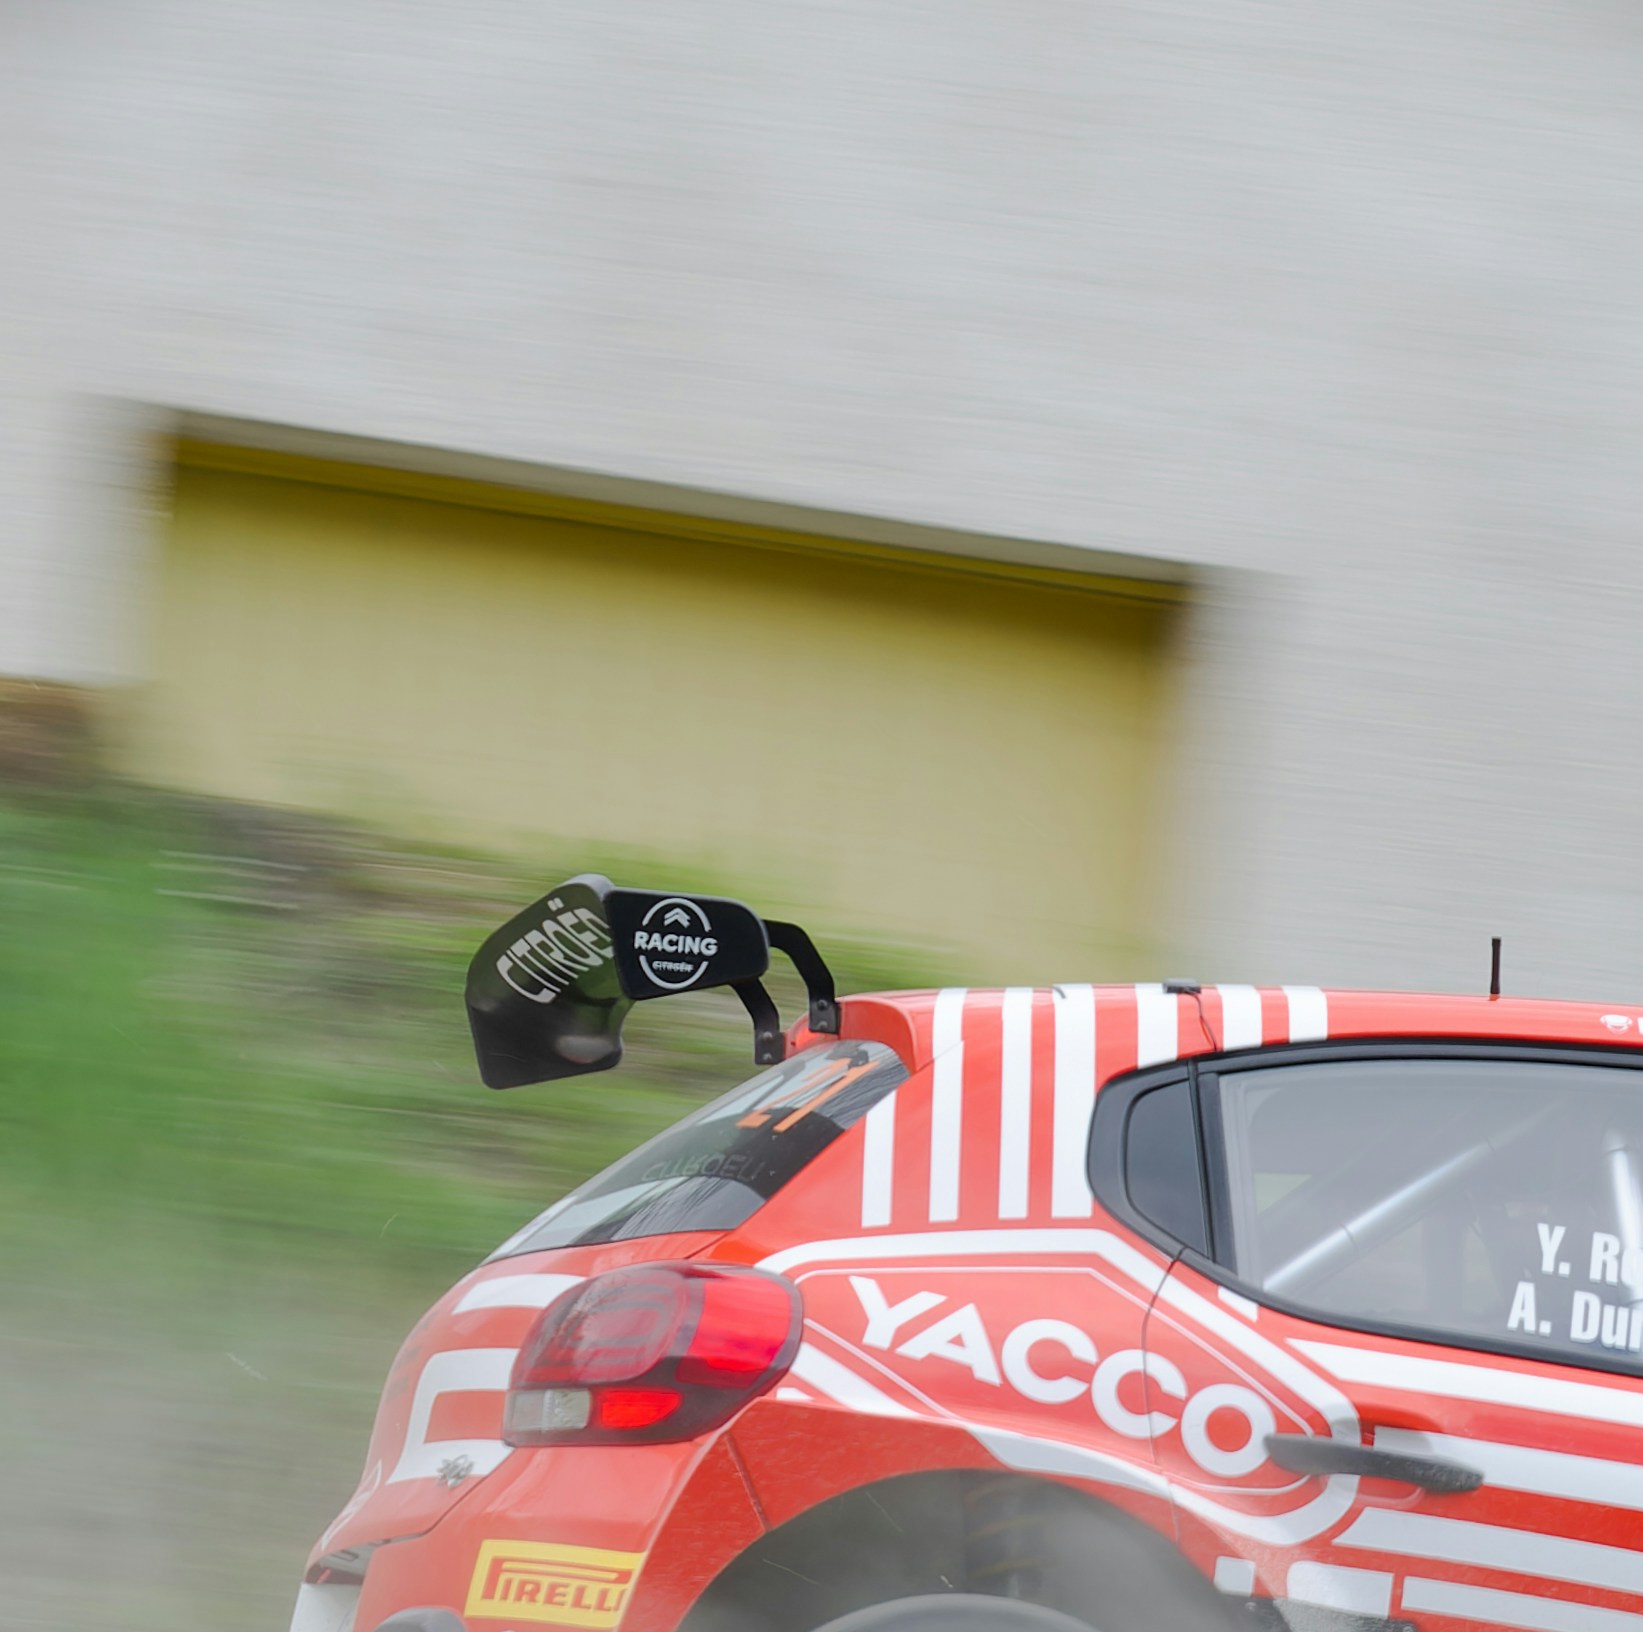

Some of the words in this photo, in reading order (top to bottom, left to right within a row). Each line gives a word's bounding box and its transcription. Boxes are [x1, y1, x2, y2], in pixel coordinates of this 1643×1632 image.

[634, 930, 717, 956] RACING
[1536, 1222, 1570, 1274] Y.
[1508, 1283, 1551, 1335] A.
[848, 1275, 1276, 1477] YACCO
[482, 1557, 638, 1612] PIRELLI
